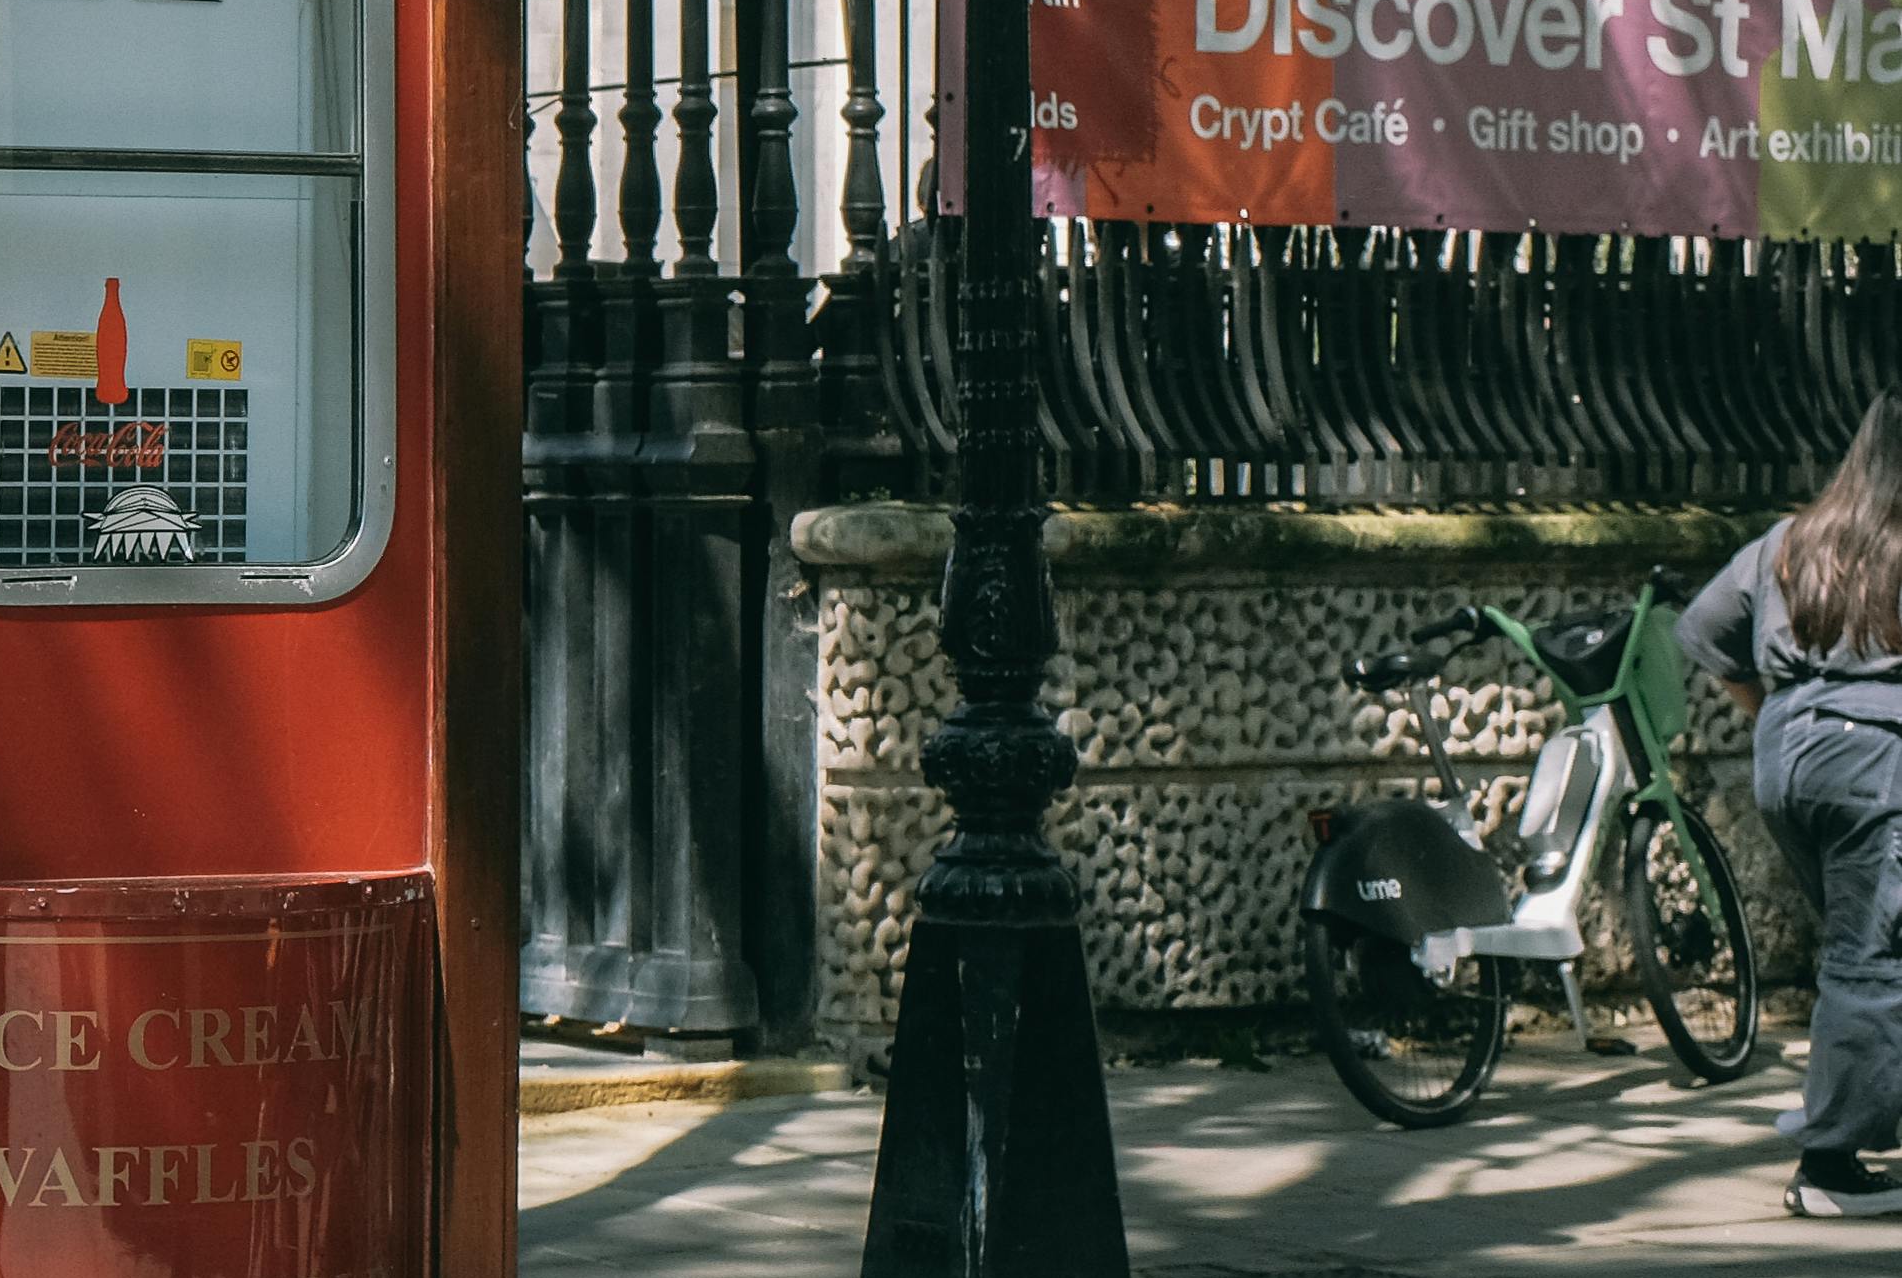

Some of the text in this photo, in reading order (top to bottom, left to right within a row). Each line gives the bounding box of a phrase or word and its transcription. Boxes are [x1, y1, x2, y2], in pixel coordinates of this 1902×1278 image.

[1190, 95, 1304, 151] Crypt
[1316, 97, 1409, 146] Café
[1468, 106, 1539, 153] Gift
[1548, 112, 1644, 164] shop
[1700, 116, 1759, 160] Art
[127, 996, 374, 1072] CREAM
